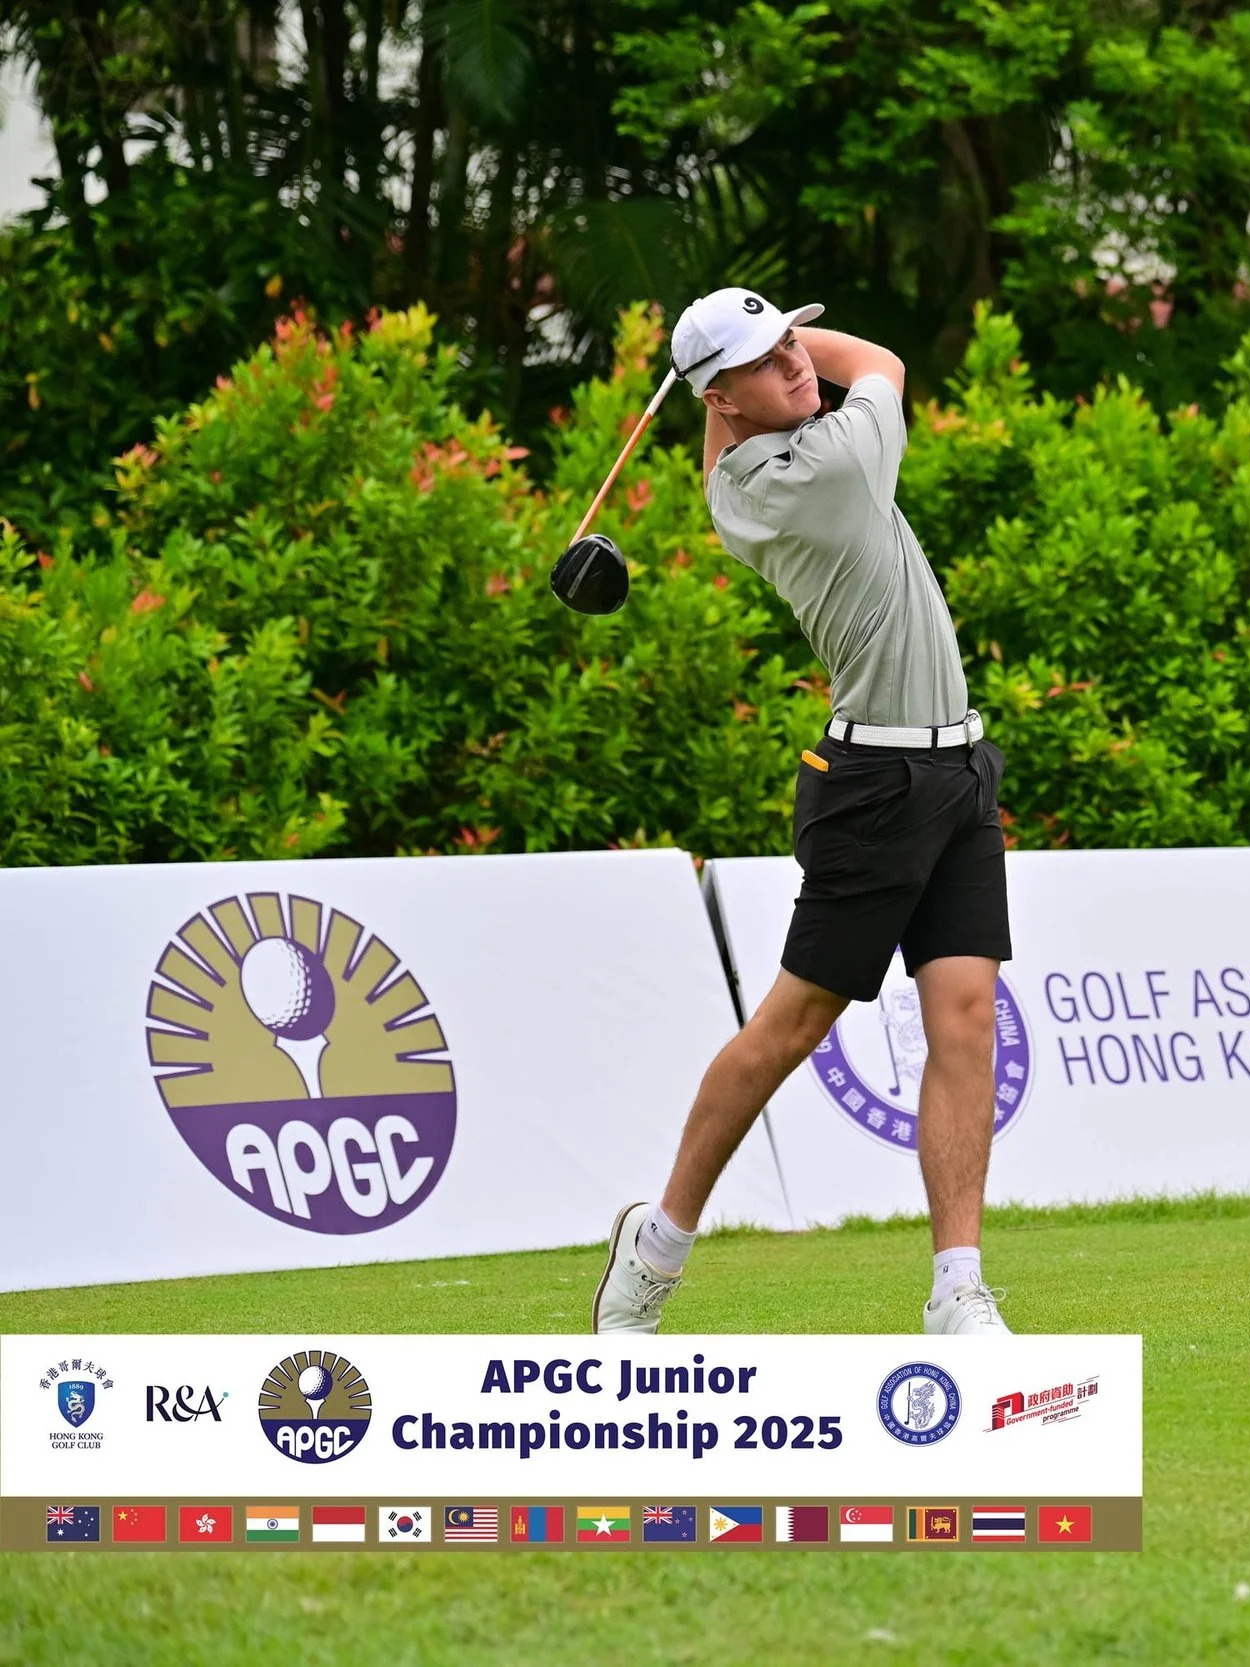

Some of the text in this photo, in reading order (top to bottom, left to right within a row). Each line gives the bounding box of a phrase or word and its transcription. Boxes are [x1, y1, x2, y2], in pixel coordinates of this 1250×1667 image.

[995, 998, 1021, 1047] CHINA
[1044, 970, 1170, 1023] GOLF
[1058, 1031, 1205, 1086] HONG
[226, 1114, 434, 1220] APGC
